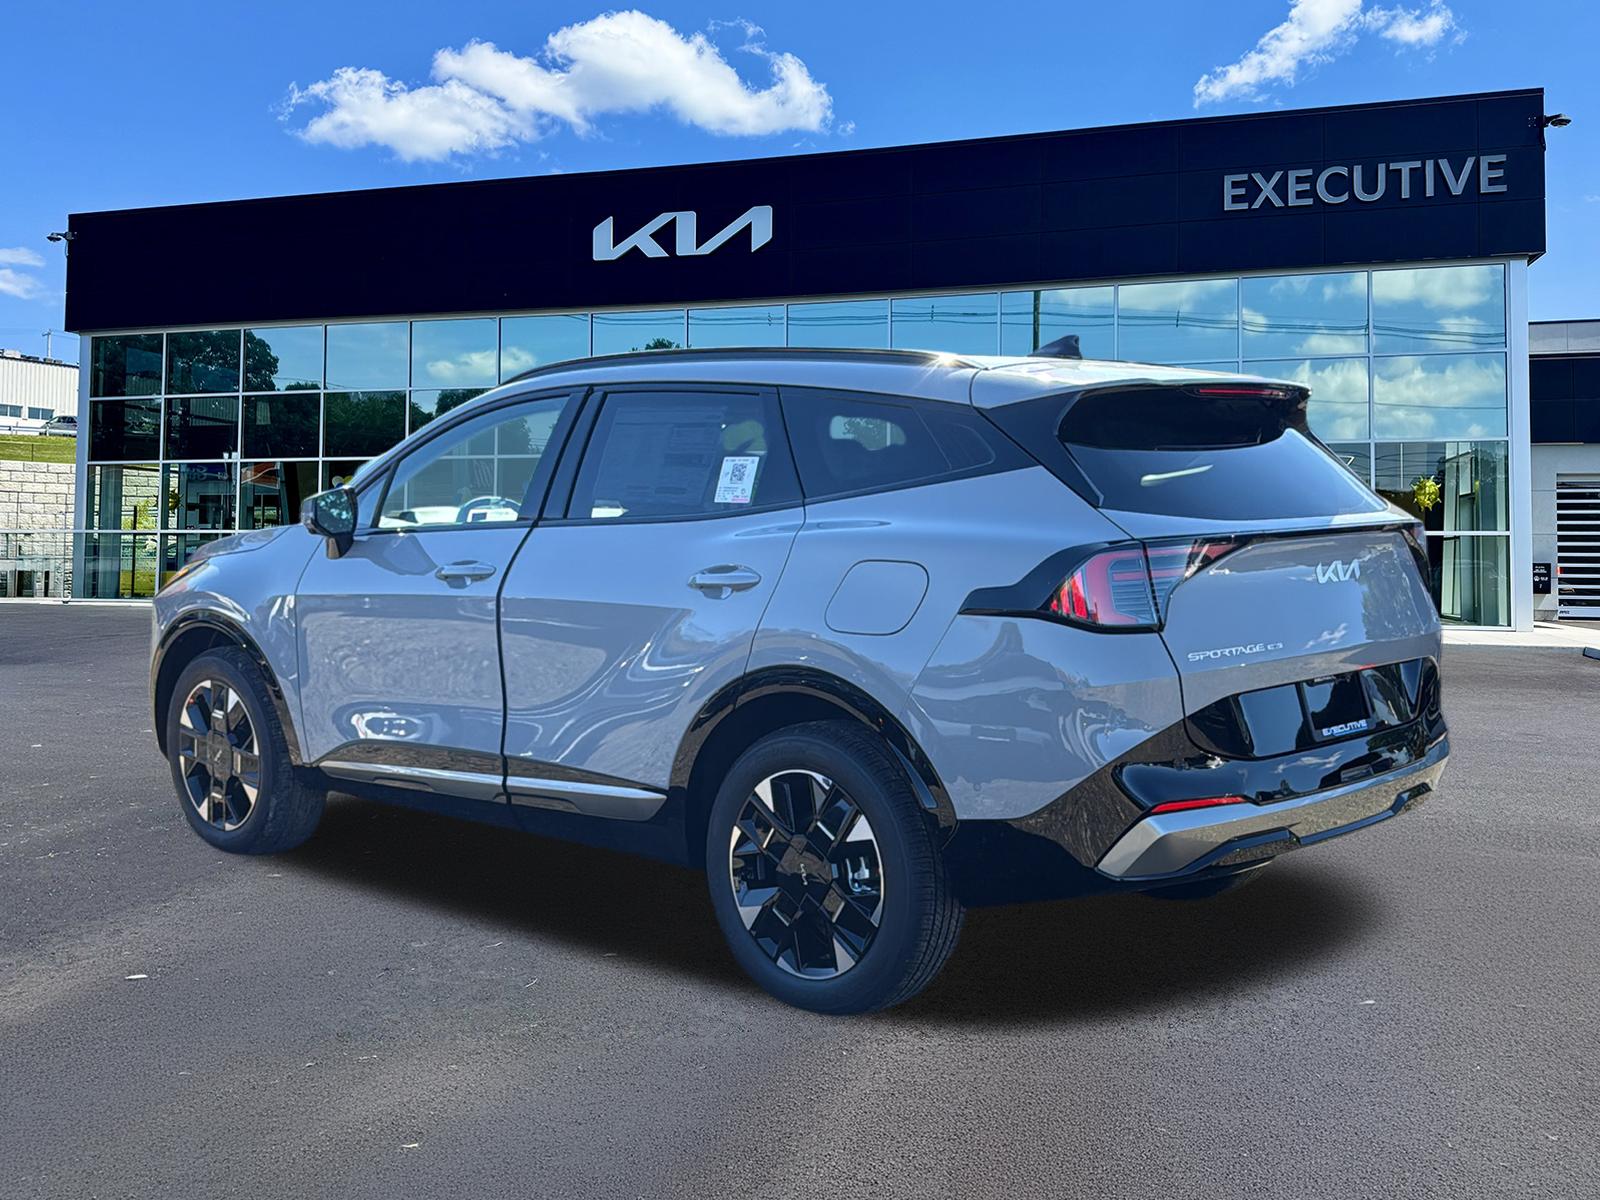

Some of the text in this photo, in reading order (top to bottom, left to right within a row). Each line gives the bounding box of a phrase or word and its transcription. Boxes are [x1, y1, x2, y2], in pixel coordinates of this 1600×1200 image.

[1224, 154, 1507, 211] EXECUTIVE
[592, 205, 773, 261] KIA
[1316, 559, 1360, 584] KIA
[1187, 643, 1266, 661] SPORTAGE
[1322, 719, 1367, 736] EXECUTIVE
